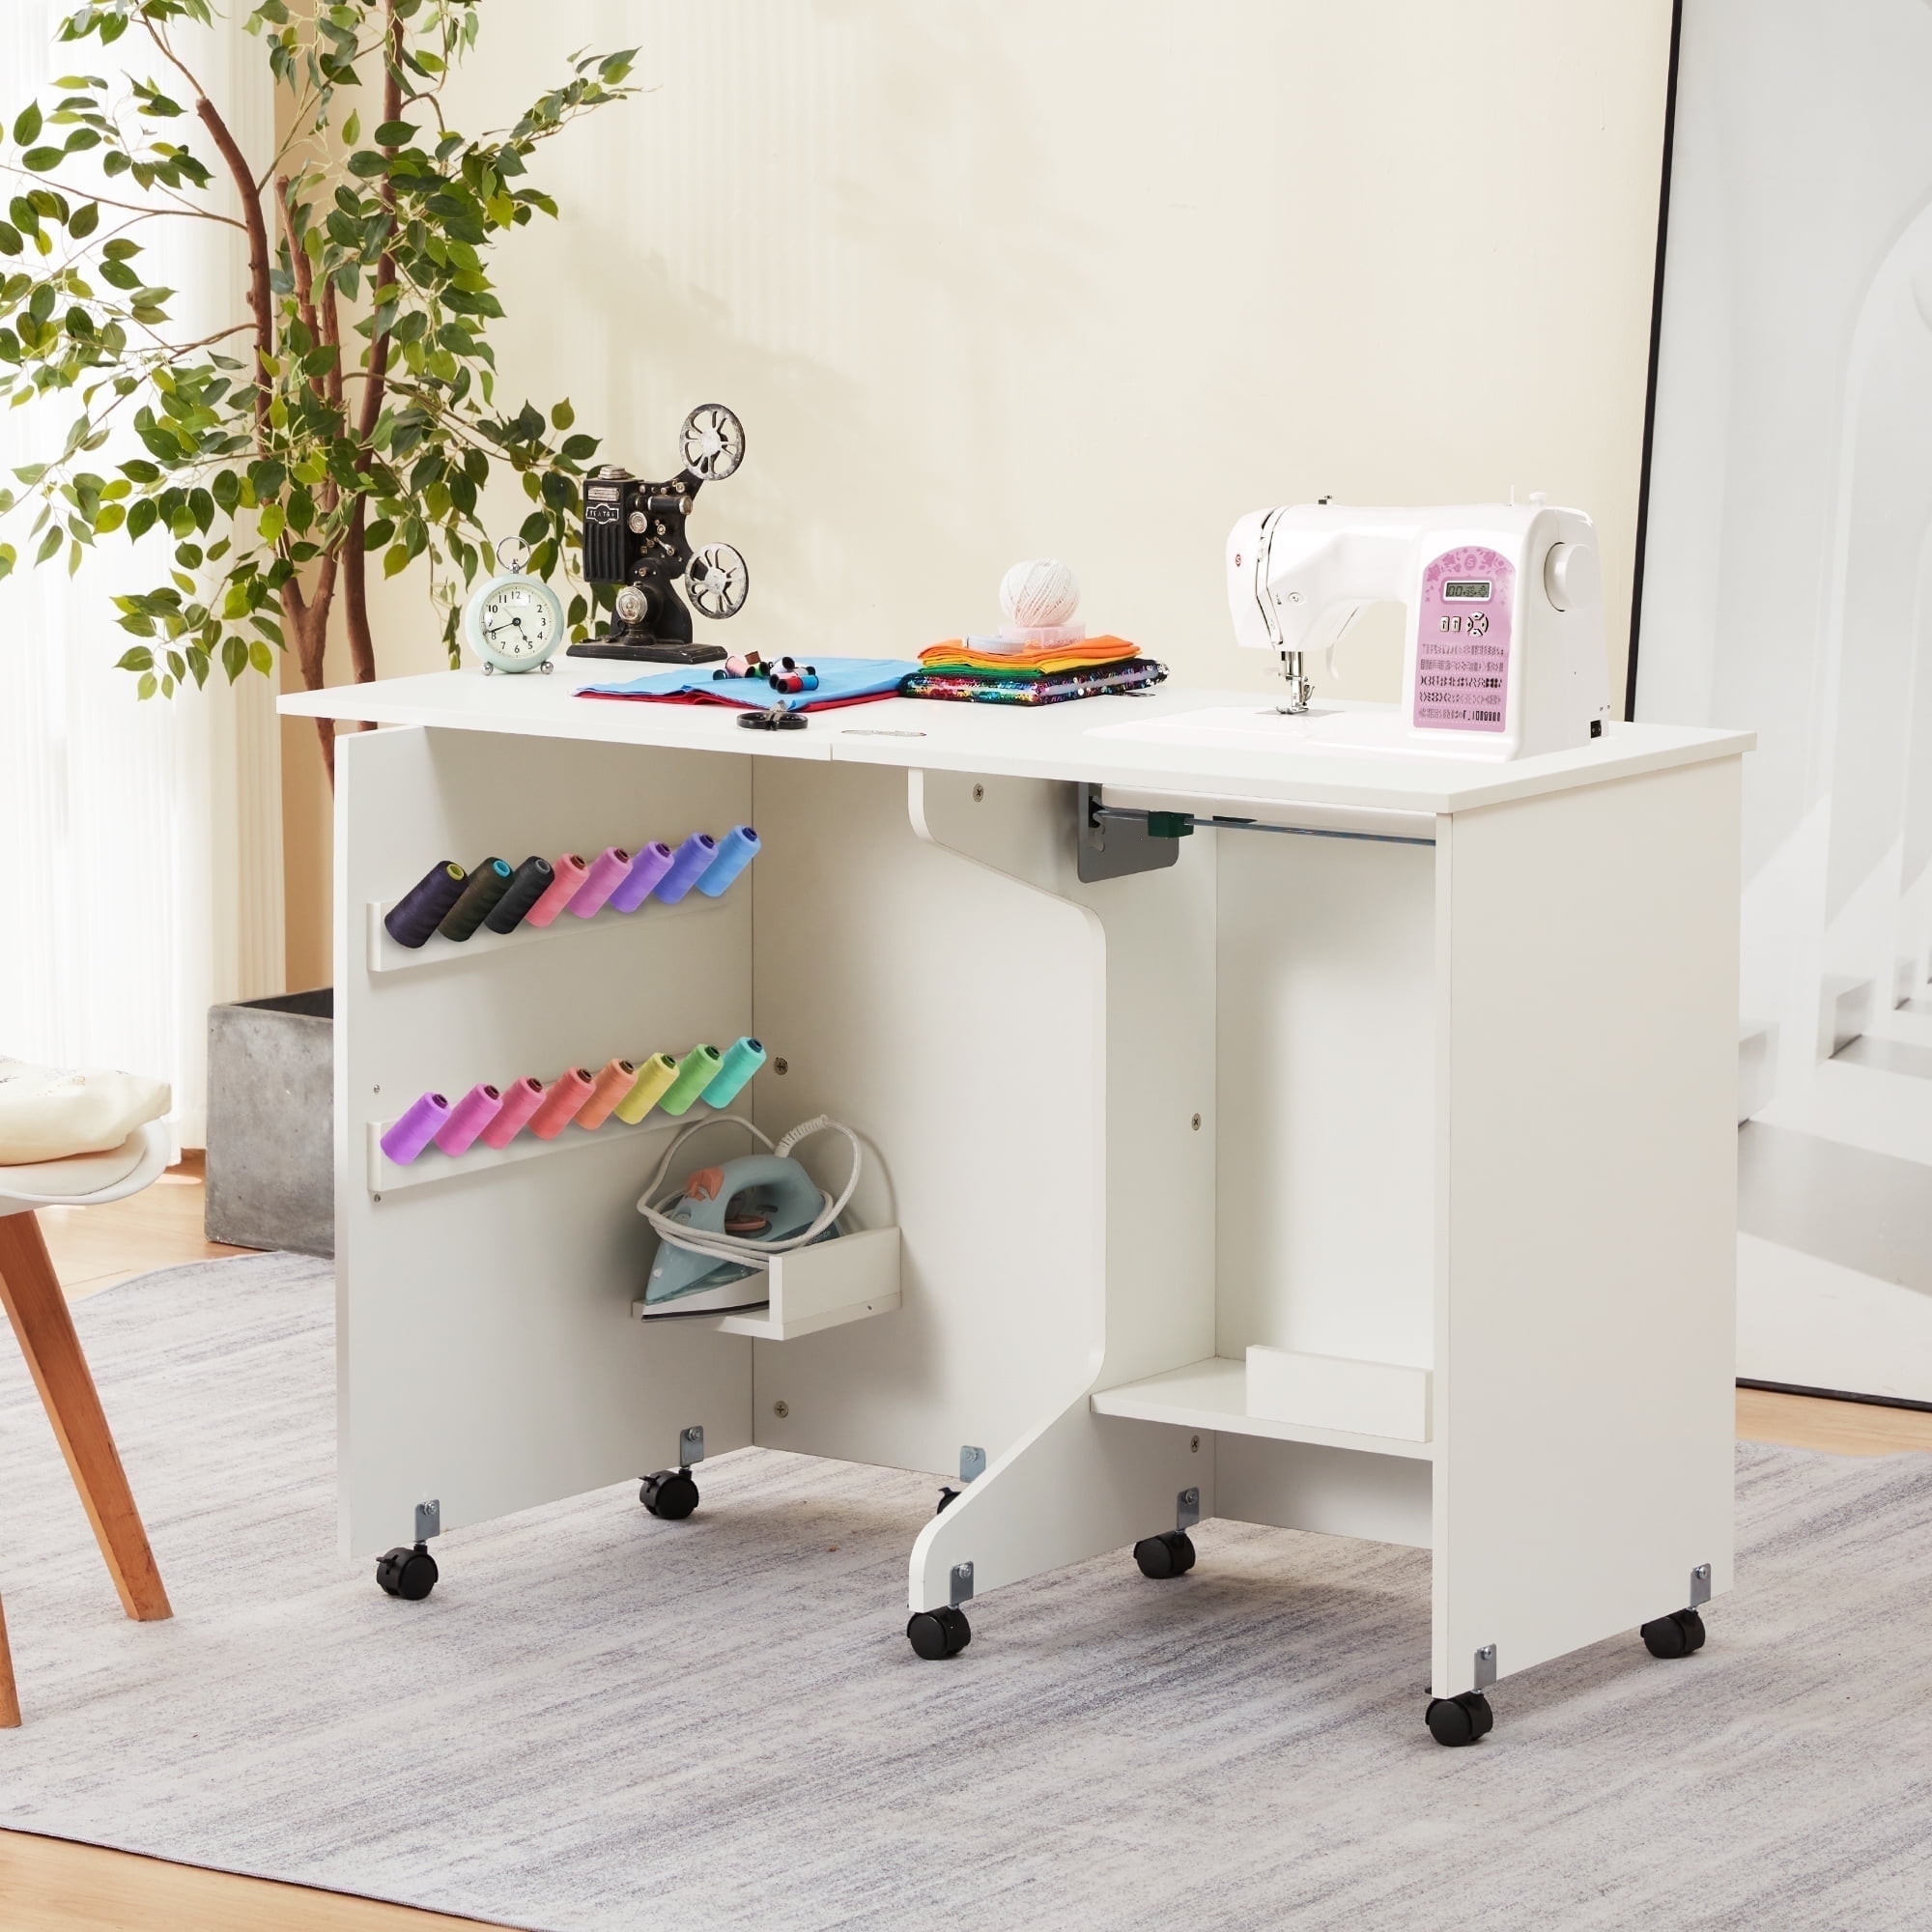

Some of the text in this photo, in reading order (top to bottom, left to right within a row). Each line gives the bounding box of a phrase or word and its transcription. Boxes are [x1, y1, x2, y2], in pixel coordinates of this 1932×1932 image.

[498, 595, 507, 604] 11
[511, 591, 521, 600] 12
[488, 605, 498, 613] 10
[536, 605, 543, 613] 2
[491, 631, 497, 640] 8
[537, 632, 543, 640] 4
[500, 641, 506, 650] 7
[514, 645, 520, 654] 6
[527, 641, 533, 650] 5
